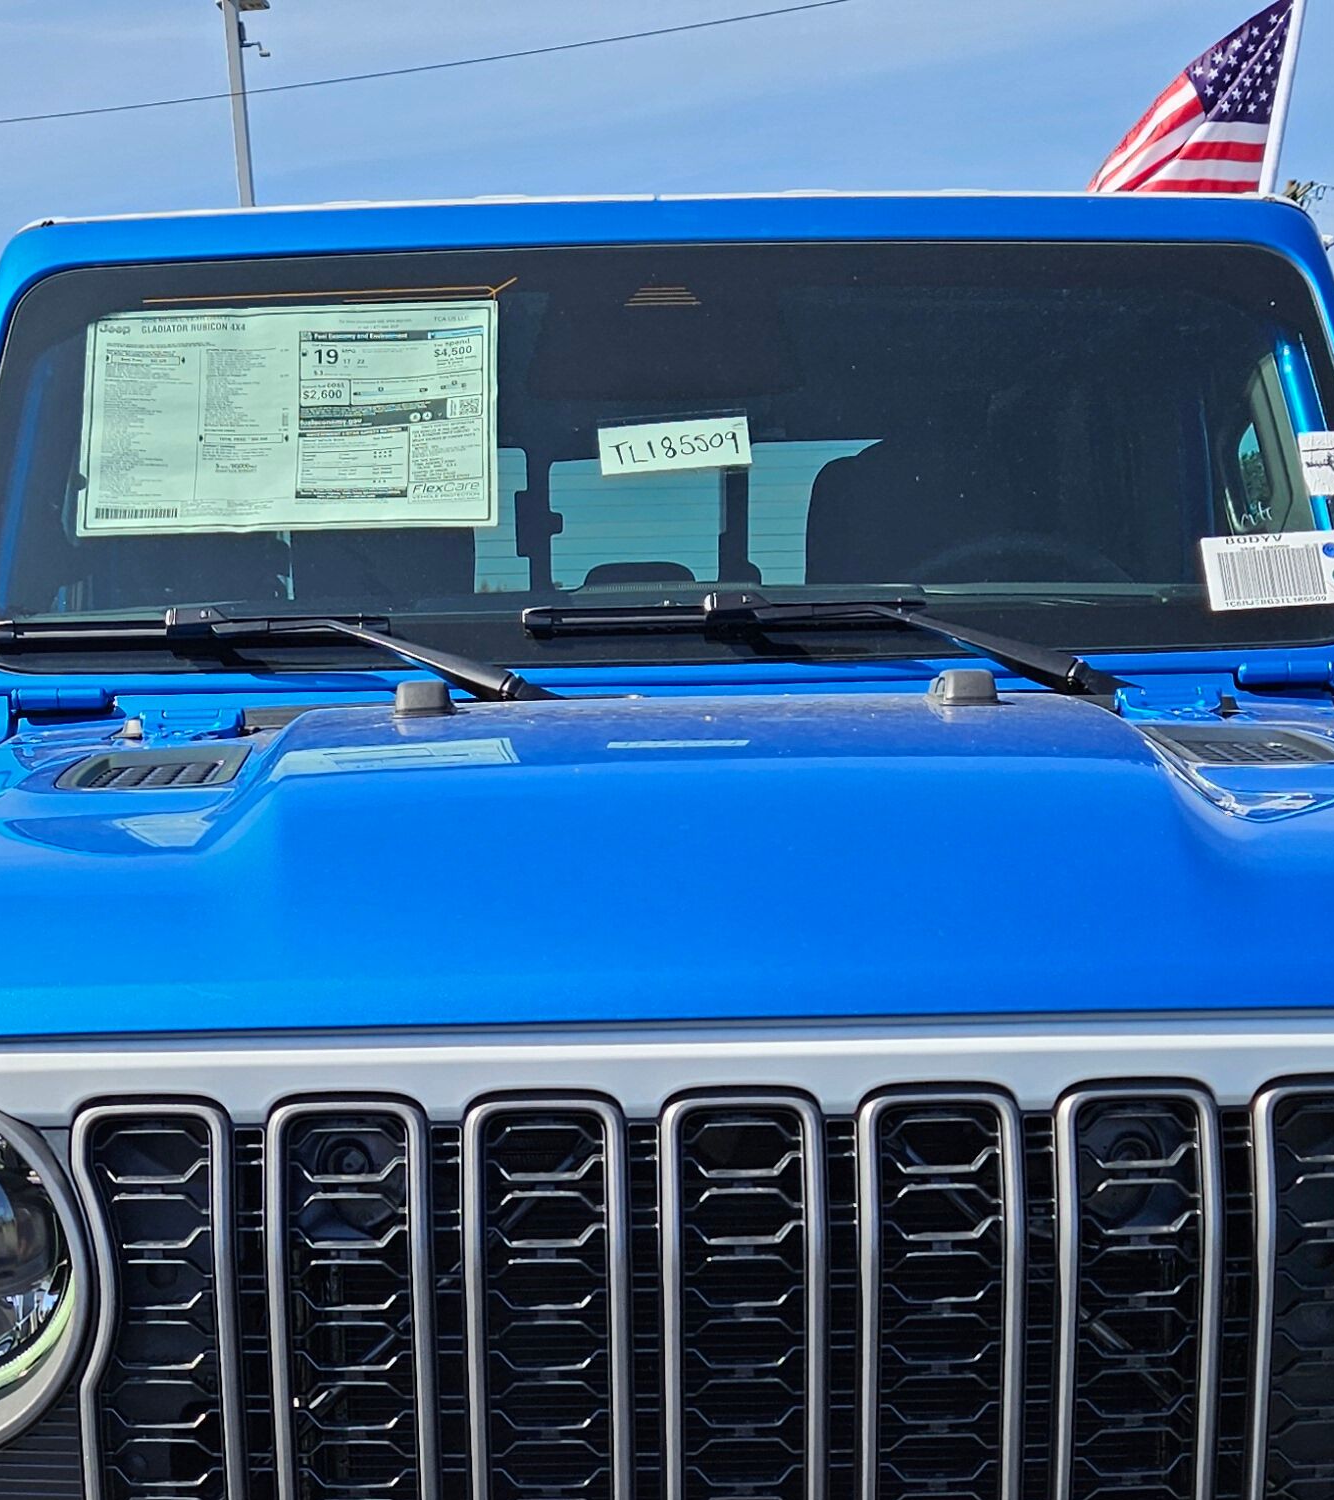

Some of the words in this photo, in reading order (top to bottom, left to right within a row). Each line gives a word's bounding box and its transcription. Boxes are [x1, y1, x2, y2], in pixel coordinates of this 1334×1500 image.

[99, 324, 130, 335] Jeep
[142, 324, 188, 334] GLADIATOR
[191, 323, 228, 332] RUBICON
[230, 323, 246, 332] 4X4
[314, 349, 338, 365] 19
[434, 345, 472, 358] $4,500
[303, 389, 342, 400] $2,600
[412, 481, 480, 494] FlexCare
